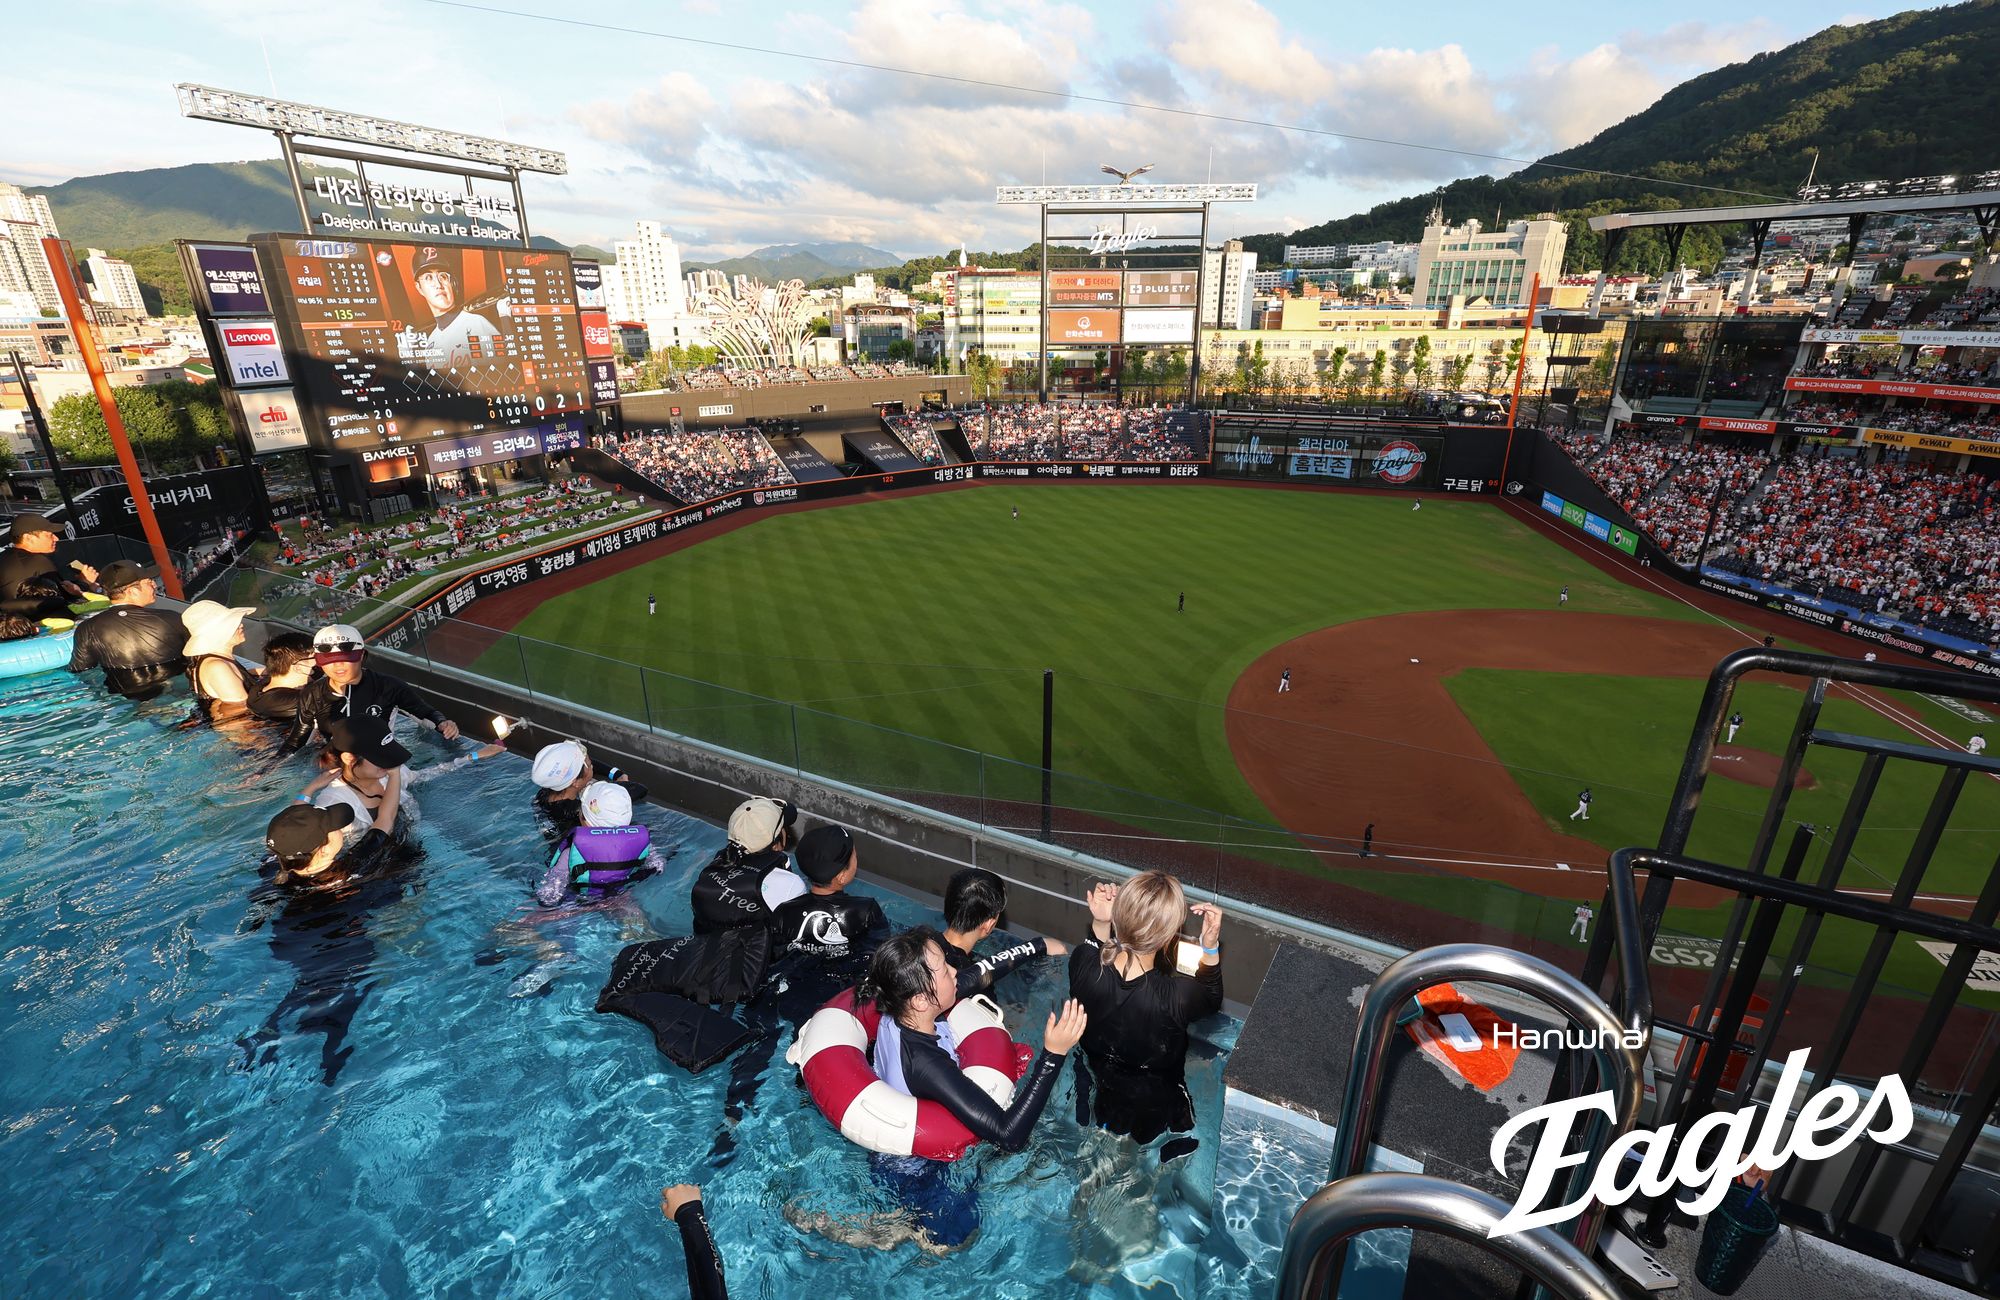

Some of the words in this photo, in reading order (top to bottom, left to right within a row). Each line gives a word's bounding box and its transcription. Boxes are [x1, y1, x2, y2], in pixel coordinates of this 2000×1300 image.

[313, 176, 364, 206] 대전
[368, 181, 455, 215] 한화생명
[321, 212, 378, 232] Daejeon
[381, 217, 440, 235] Hanwha
[444, 223, 468, 237] Life
[471, 224, 521, 241] Ballpark
[1090, 222, 1158, 255] Eagles
[205, 270, 258, 283] 에스앤케이
[303, 265, 310, 274] 3
[574, 267, 599, 276] K-water
[240, 283, 262, 294] 병원
[297, 277, 322, 286] 라일리
[1145, 285, 1169, 293] PLUS
[1172, 285, 1191, 293] ETF
[334, 309, 353, 320] 135
[391, 320, 404, 331] 22
[229, 332, 271, 344] Lenovo
[239, 361, 281, 379] intel
[338, 412, 369, 421] NC다이노스
[373, 410, 381, 420] 2
[385, 408, 393, 419] 0
[486, 397, 493, 406] 2
[495, 396, 502, 405] 4
[504, 395, 510, 404] 0
[512, 394, 519, 403] 0
[520, 393, 527, 402] 2
[535, 396, 546, 411] 0
[556, 393, 566, 409] 2
[576, 391, 583, 406] 1
[341, 426, 370, 437] 한화이글스
[377, 424, 385, 434] 0
[388, 422, 396, 432] 0
[489, 410, 495, 419] 0
[499, 408, 504, 418] 1
[506, 407, 513, 417] 0
[514, 406, 521, 416] 0
[522, 405, 529, 415] 0
[555, 422, 567, 433] 부여
[1646, 416, 1676, 424] aramark
[1725, 421, 1768, 431] INNINGS
[545, 430, 580, 444] 서동연꽃축제
[1794, 426, 1828, 434] aramark
[492, 434, 537, 454] 크리넥스
[1298, 437, 1349, 452] 갤러리아
[363, 446, 415, 462] BAMKEL
[433, 448, 466, 463] 깨끗함의
[466, 445, 482, 458] 진심
[1235, 435, 1275, 473] Galleria
[1371, 449, 1427, 474] Eagles
[1089, 465, 1114, 476] 부루펜
[1170, 466, 1199, 476] DEEPS
[1295, 455, 1346, 474] 홈런존
[934, 465, 973, 481] 대방건설
[1443, 478, 1484, 492] 구르닭
[765, 489, 798, 498] 목원대학교
[586, 533, 621, 557] 예가정성
[624, 523, 657, 544] 로제비앙
[1712, 583, 1726, 592] 2025
[1784, 603, 1834, 624] 한국폴리텍대학
[709, 871, 728, 887] And
[718, 887, 760, 912] Free
[660, 935, 695, 960] Free
[991, 942, 1036, 964] Hurley
[1649, 945, 1739, 969] GS2
[609, 951, 651, 994] Young
